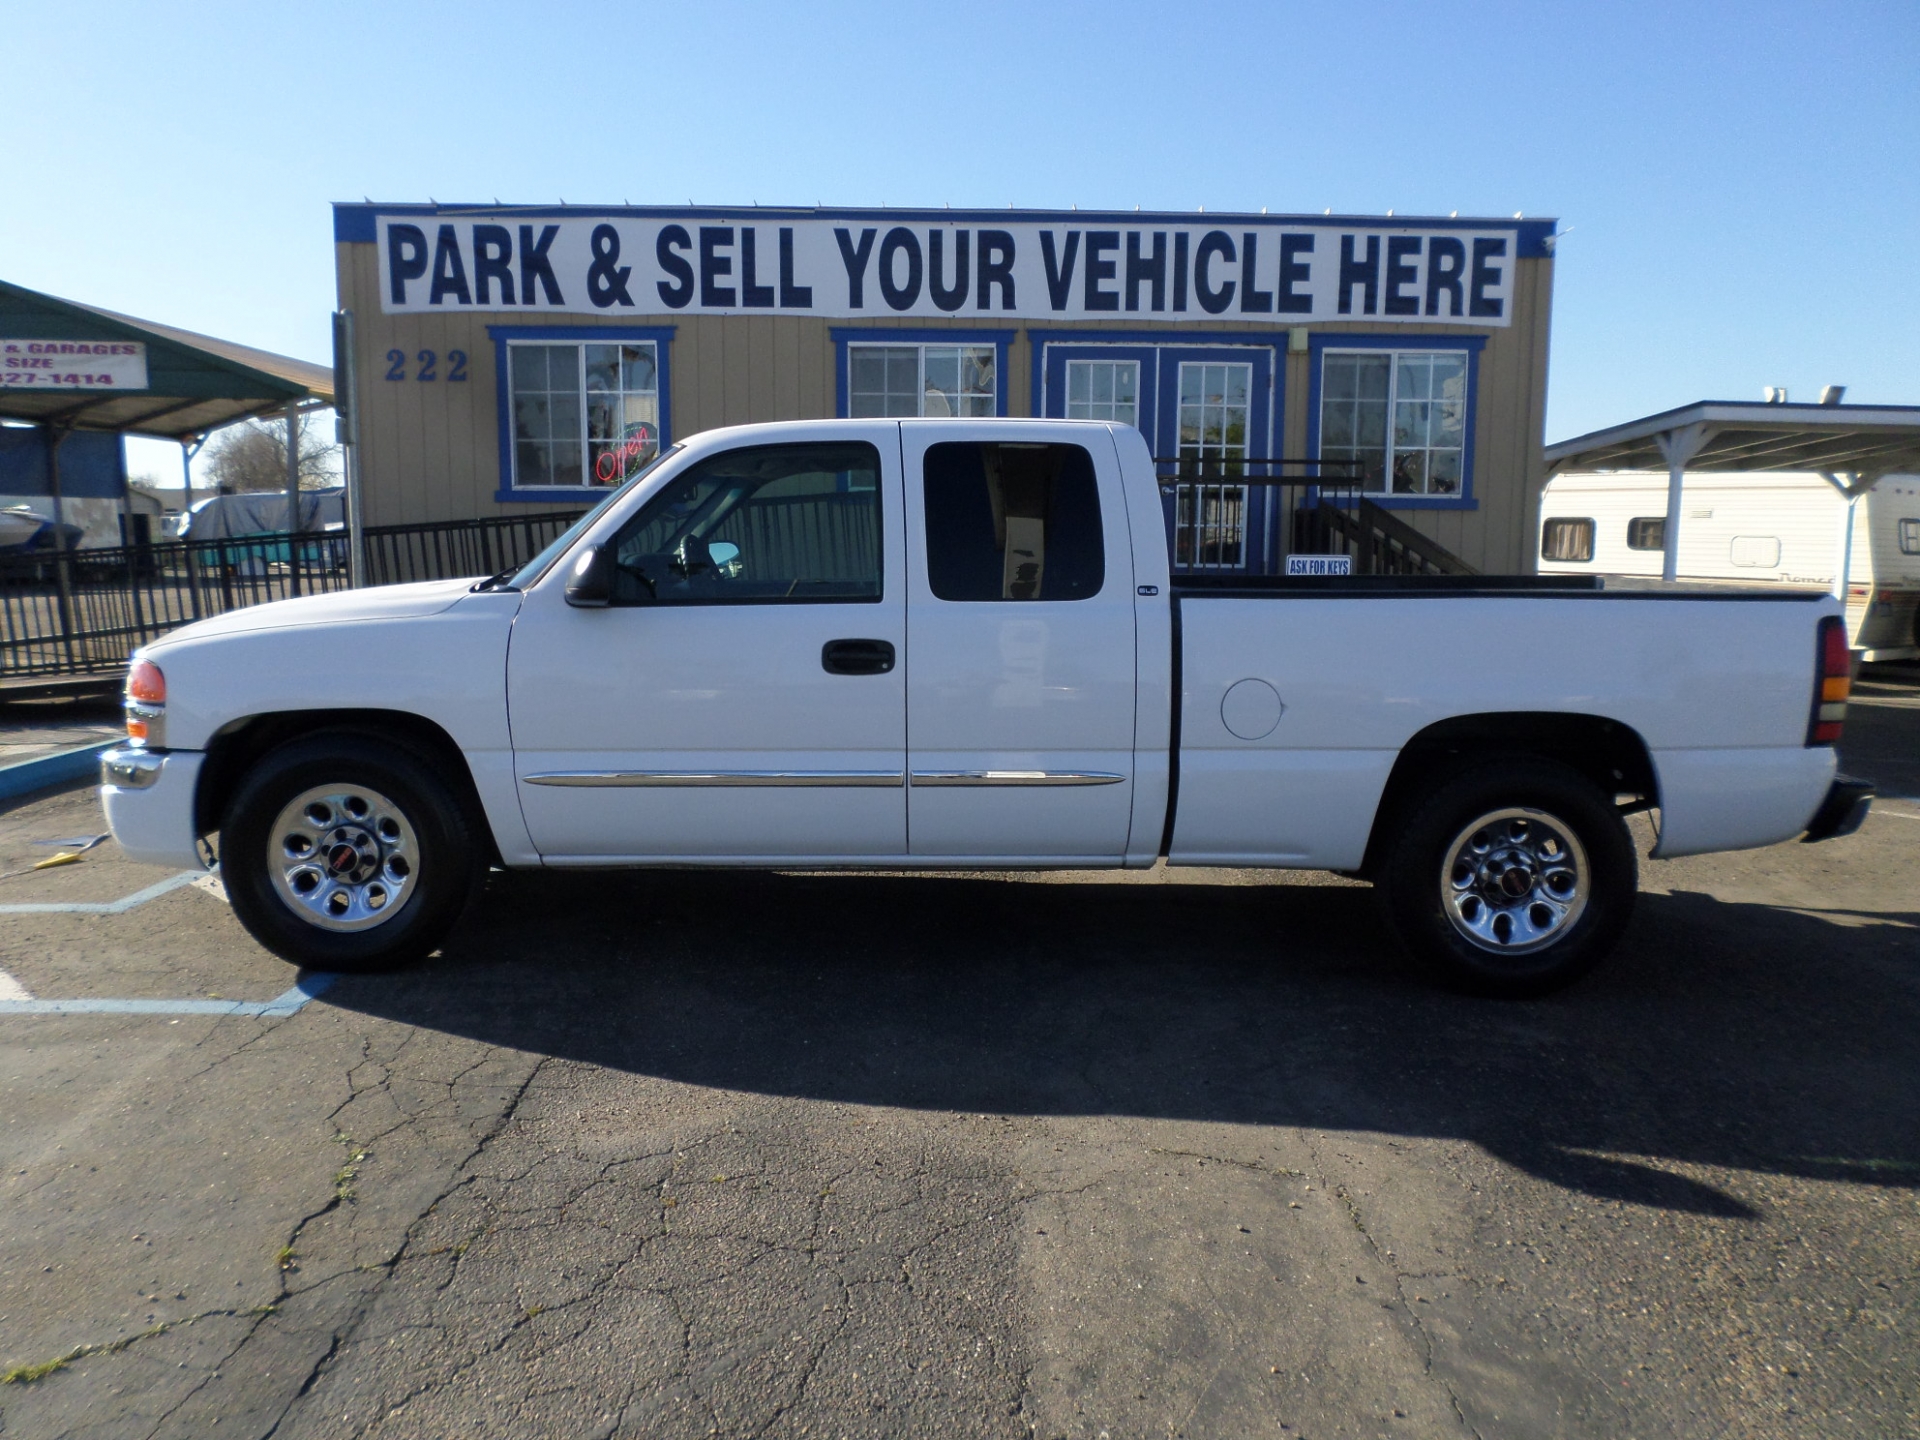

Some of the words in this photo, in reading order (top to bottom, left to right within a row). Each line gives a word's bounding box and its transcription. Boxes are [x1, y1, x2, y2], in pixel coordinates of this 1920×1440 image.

[387, 223, 566, 306] PARK
[586, 223, 636, 309] &
[655, 224, 813, 309] SELL
[833, 226, 1017, 312] YOUR
[1038, 229, 1316, 315] VEHICLE
[1337, 234, 1508, 318] HERE
[5, 345, 19, 353] &
[28, 343, 136, 355] GARAGES
[5, 357, 53, 369] SIZE
[0, 372, 113, 385] 27-1414
[1290, 560, 1308, 574] ASK
[1309, 560, 1326, 574] FOR
[1327, 560, 1349, 575] KEYS
